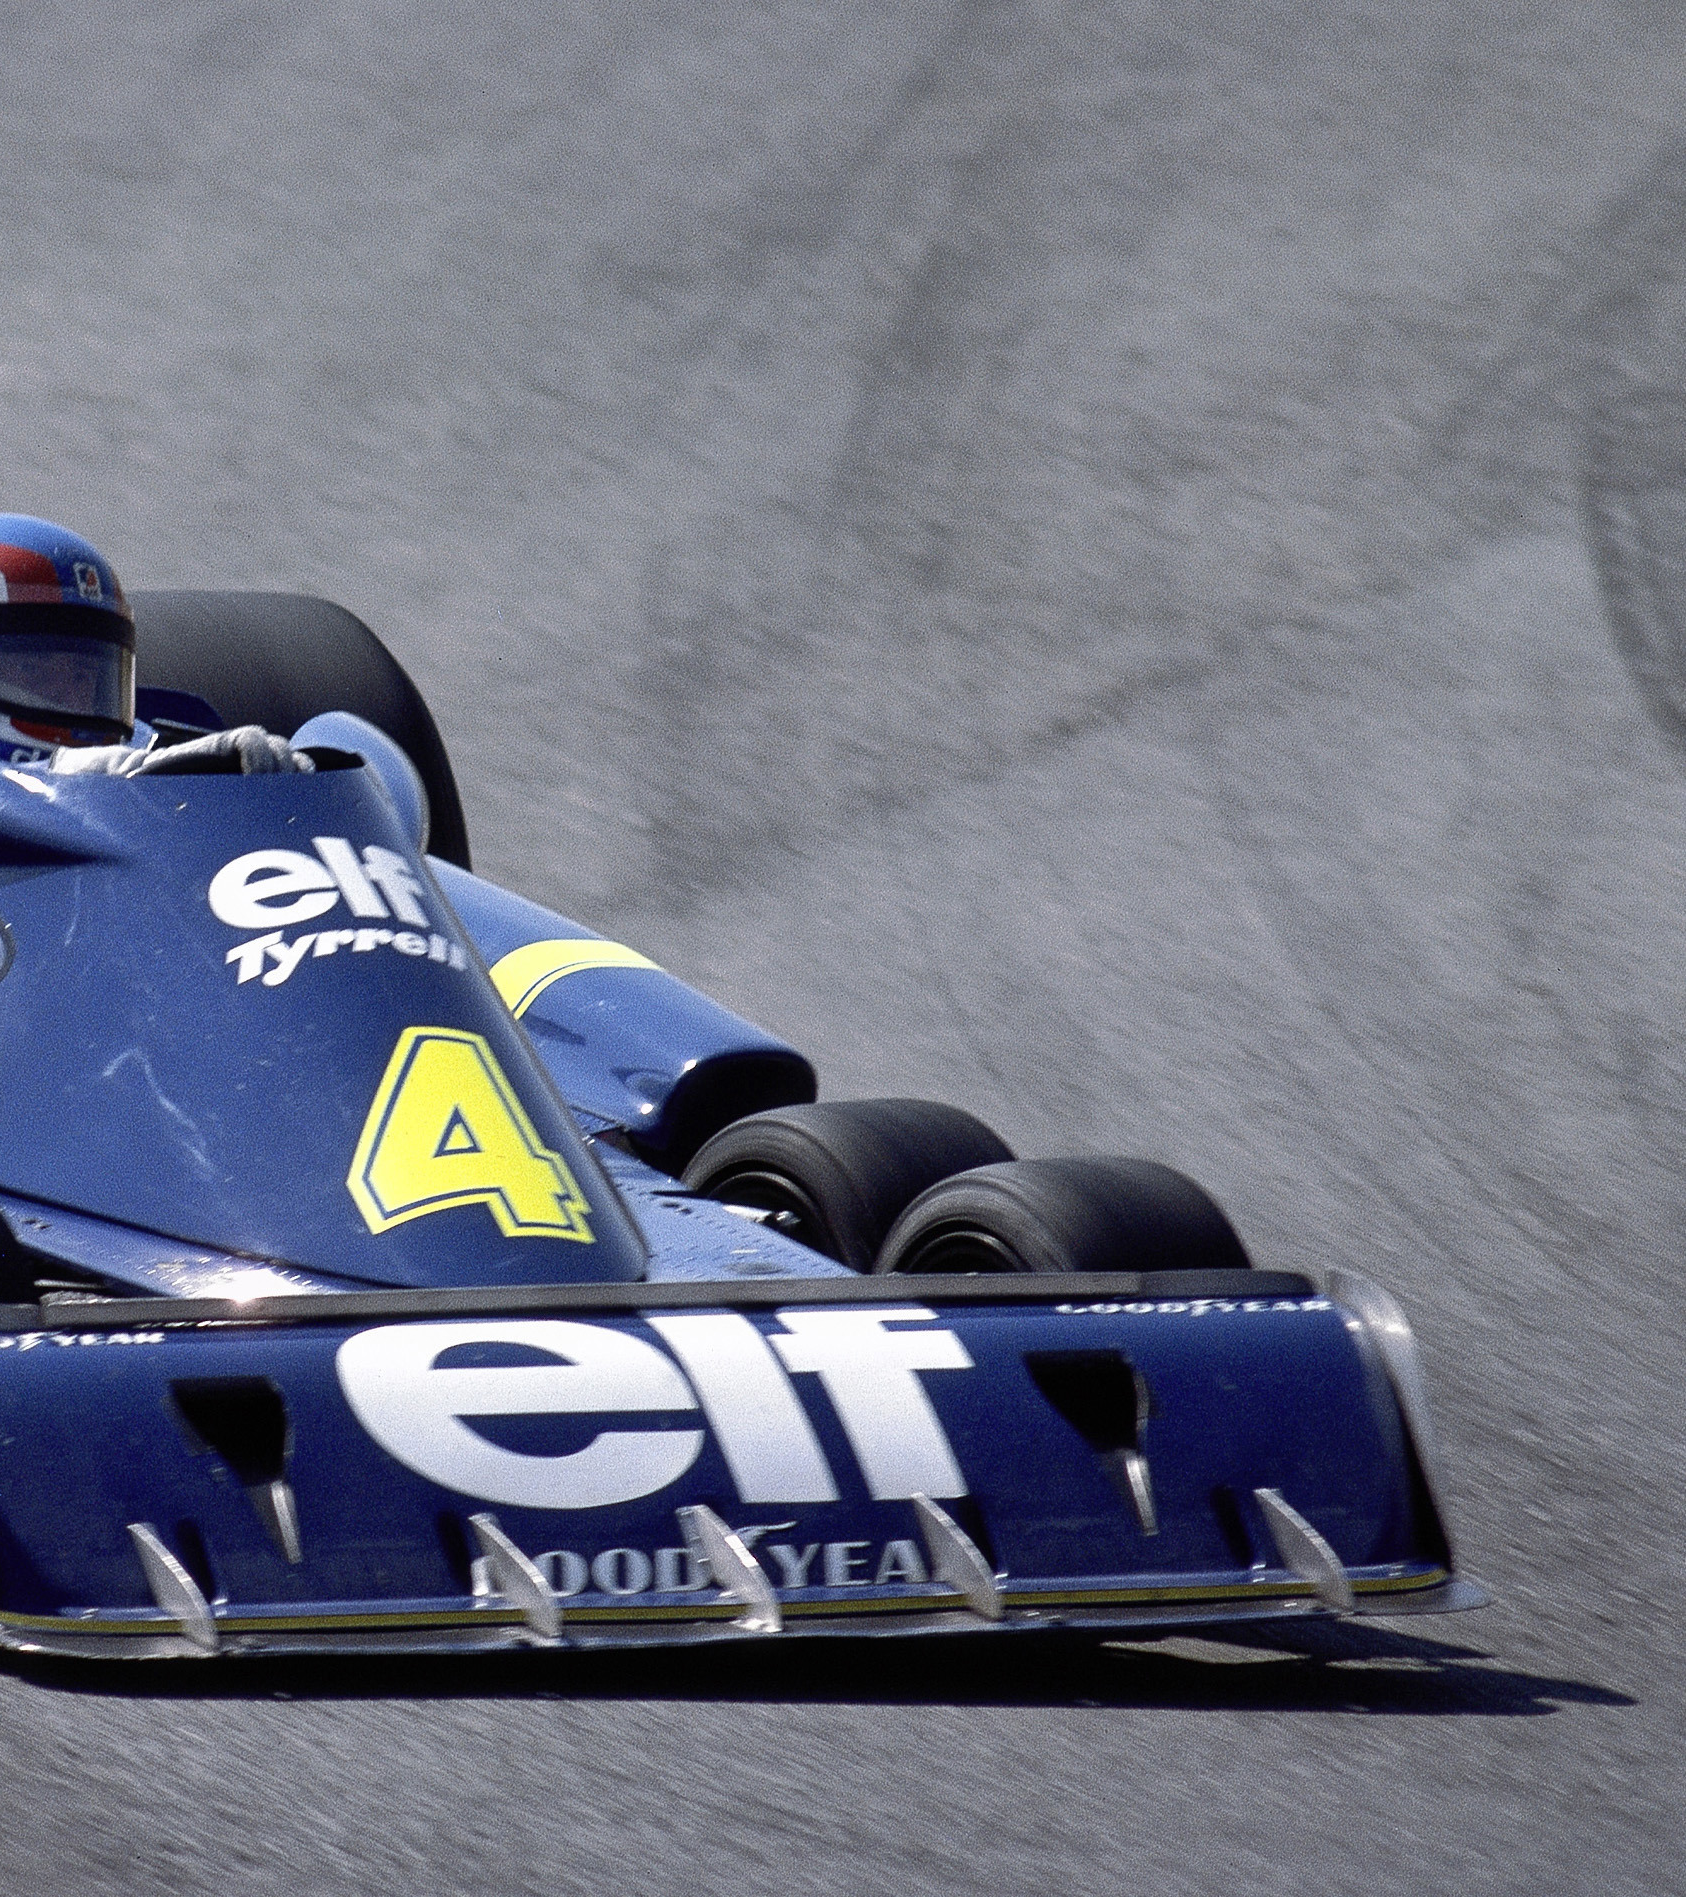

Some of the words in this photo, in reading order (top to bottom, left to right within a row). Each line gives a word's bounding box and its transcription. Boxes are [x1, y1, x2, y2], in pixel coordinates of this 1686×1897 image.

[209, 837, 429, 928] elf
[226, 928, 468, 987] Tyrrell
[346, 1026, 596, 1244] 4
[1055, 1299, 1334, 1315] GOODYEAR
[336, 1308, 976, 1509] elf
[469, 1539, 951, 1598] OODYEA
